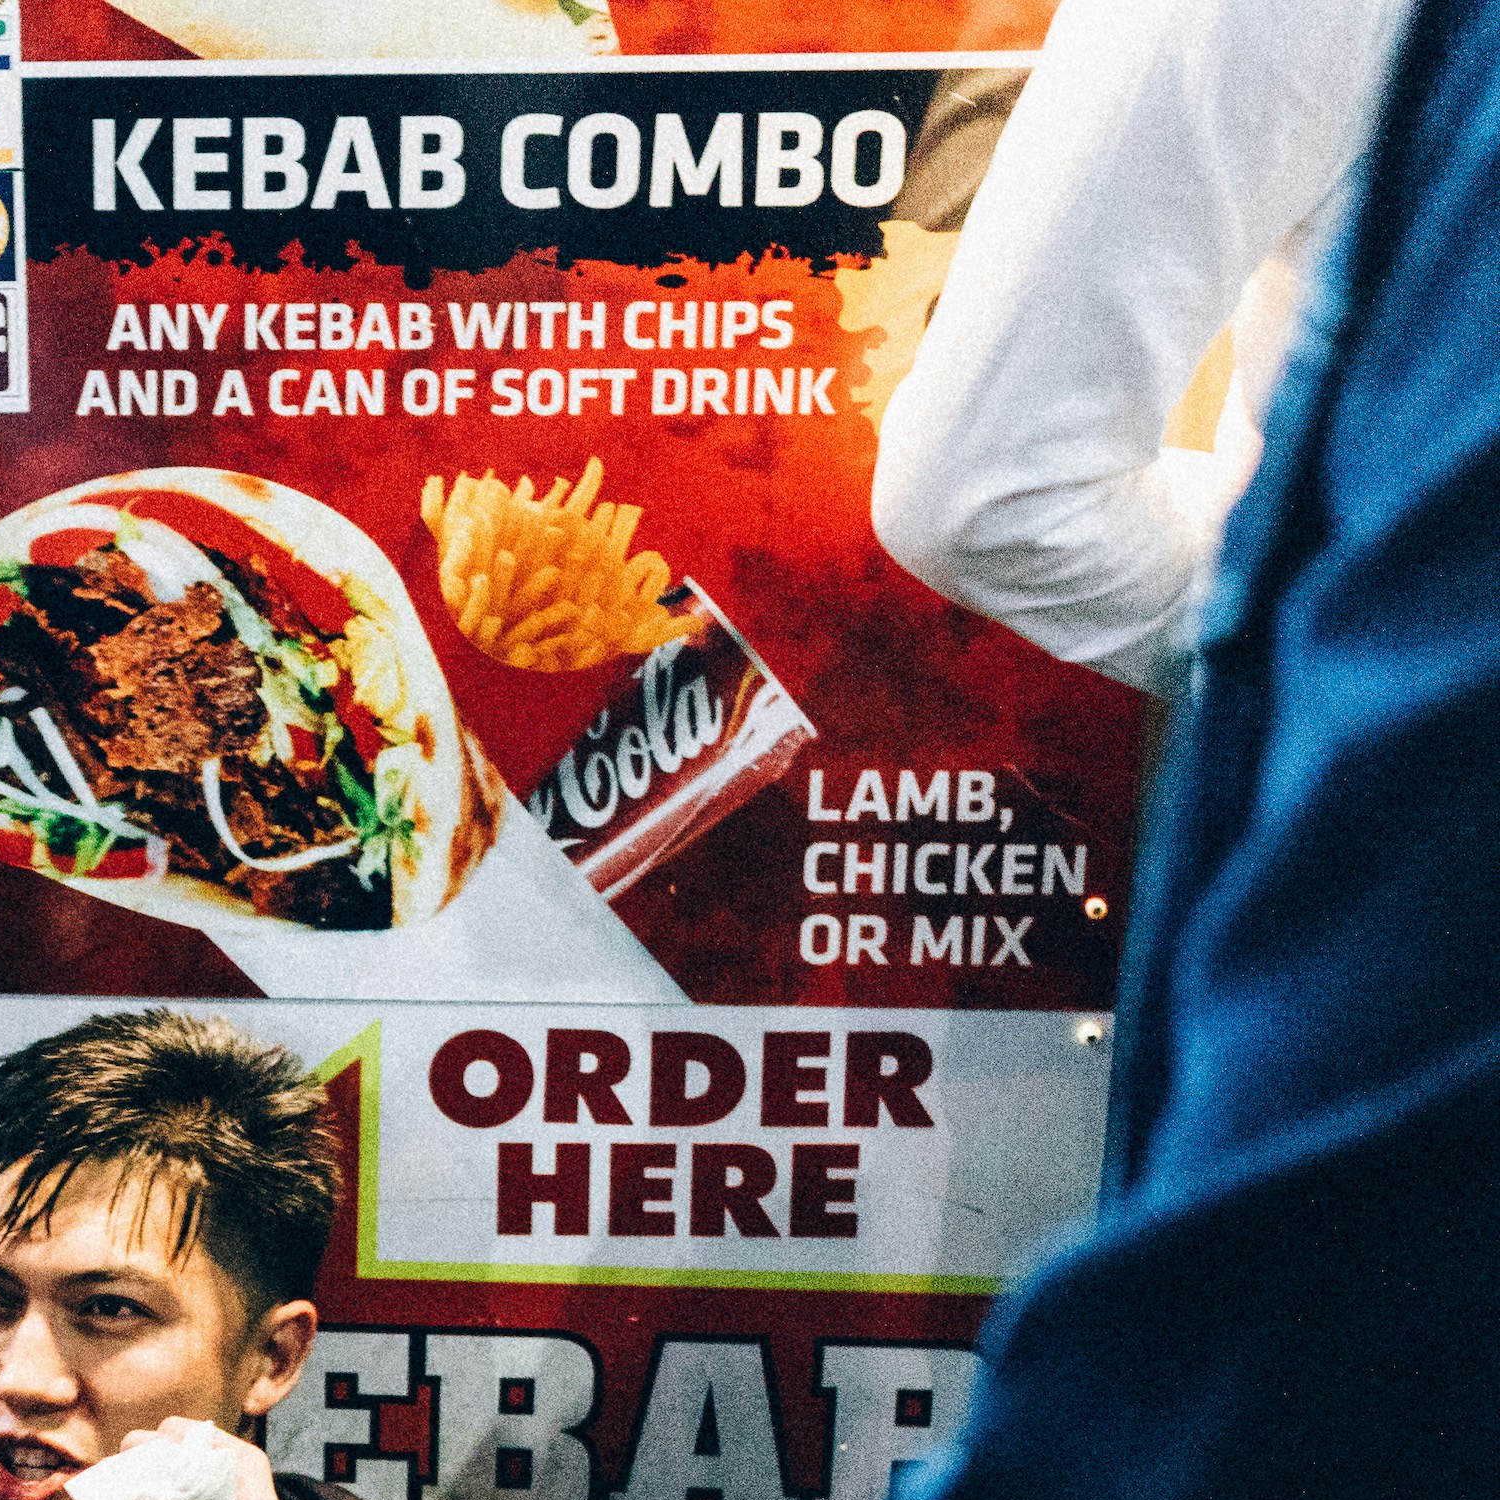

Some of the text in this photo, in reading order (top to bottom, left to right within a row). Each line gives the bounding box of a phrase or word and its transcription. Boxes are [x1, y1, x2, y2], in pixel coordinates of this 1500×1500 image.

[92, 110, 907, 211] KEBAB COMBO
[106, 301, 794, 351] ANY KEBAB WITH CHIPS
[76, 367, 837, 416] AND A CAN OF SOFT DRINK
[808, 770, 1014, 833] LAMB,
[803, 842, 1088, 895] CHICKEN
[800, 913, 1035, 967] OR MIX
[428, 1028, 935, 1129] ORDER
[496, 1142, 861, 1239] HERE
